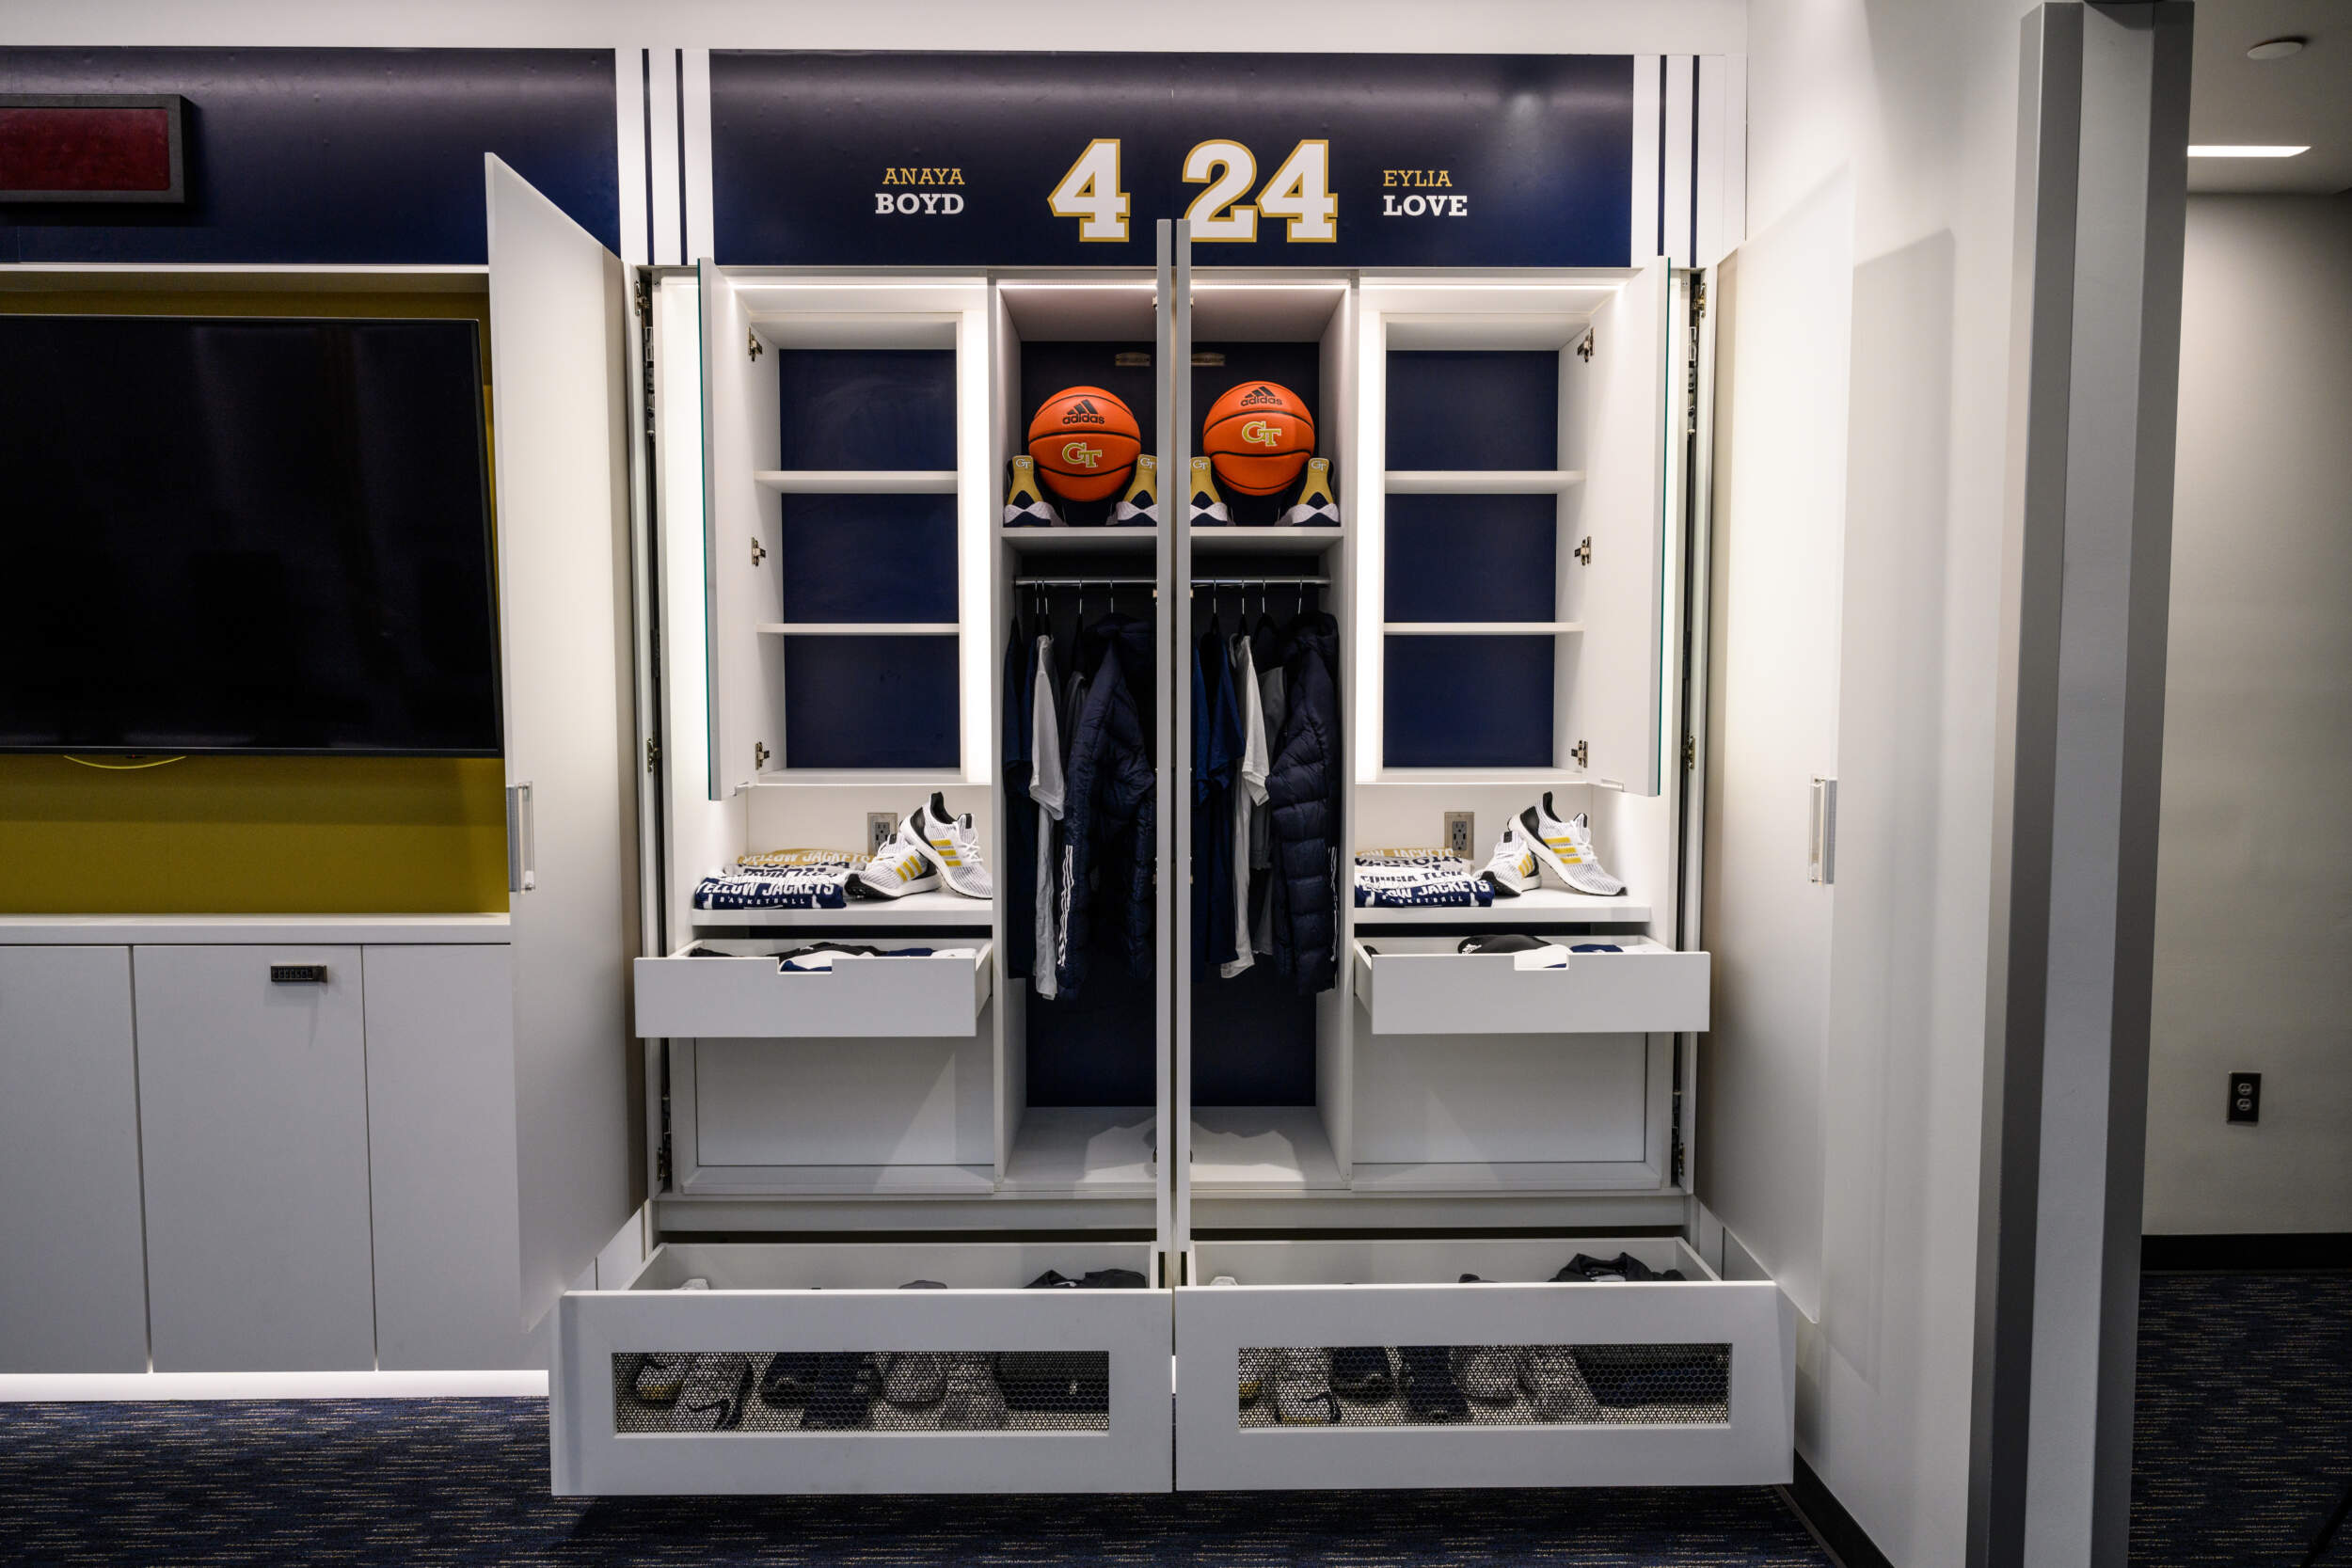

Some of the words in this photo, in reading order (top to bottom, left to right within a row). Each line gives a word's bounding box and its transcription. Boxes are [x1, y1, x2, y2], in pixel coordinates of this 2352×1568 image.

[882, 167, 965, 186] ANAYA
[1383, 170, 1453, 188] EYLIA
[1047, 138, 1130, 243] 4
[1182, 139, 1338, 243] 24
[875, 193, 965, 215] BOYD
[1383, 195, 1469, 217] LOVE
[1240, 393, 1283, 407] adidas
[1062, 411, 1105, 425] adidas
[1242, 421, 1281, 447] GT
[1062, 442, 1103, 468] GT
[1418, 879, 1491, 896] JACKETS
